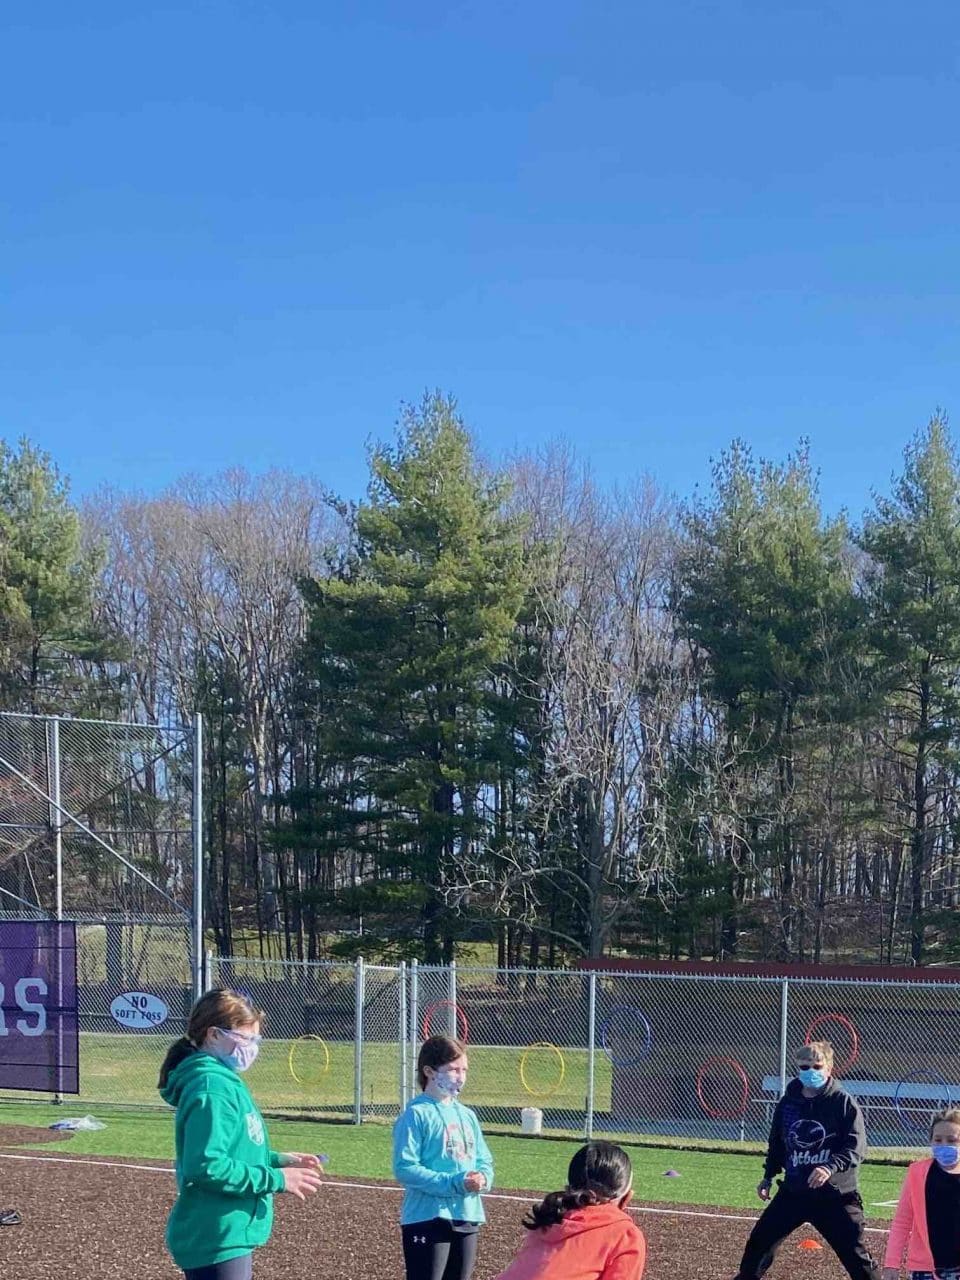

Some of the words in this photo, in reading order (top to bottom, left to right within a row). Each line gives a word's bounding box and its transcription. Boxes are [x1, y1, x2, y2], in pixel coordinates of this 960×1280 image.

[0, 977, 48, 1036] S
[131, 996, 148, 1008] NO
[115, 1009, 137, 1019] SOFT
[141, 1011, 162, 1021] TOSS
